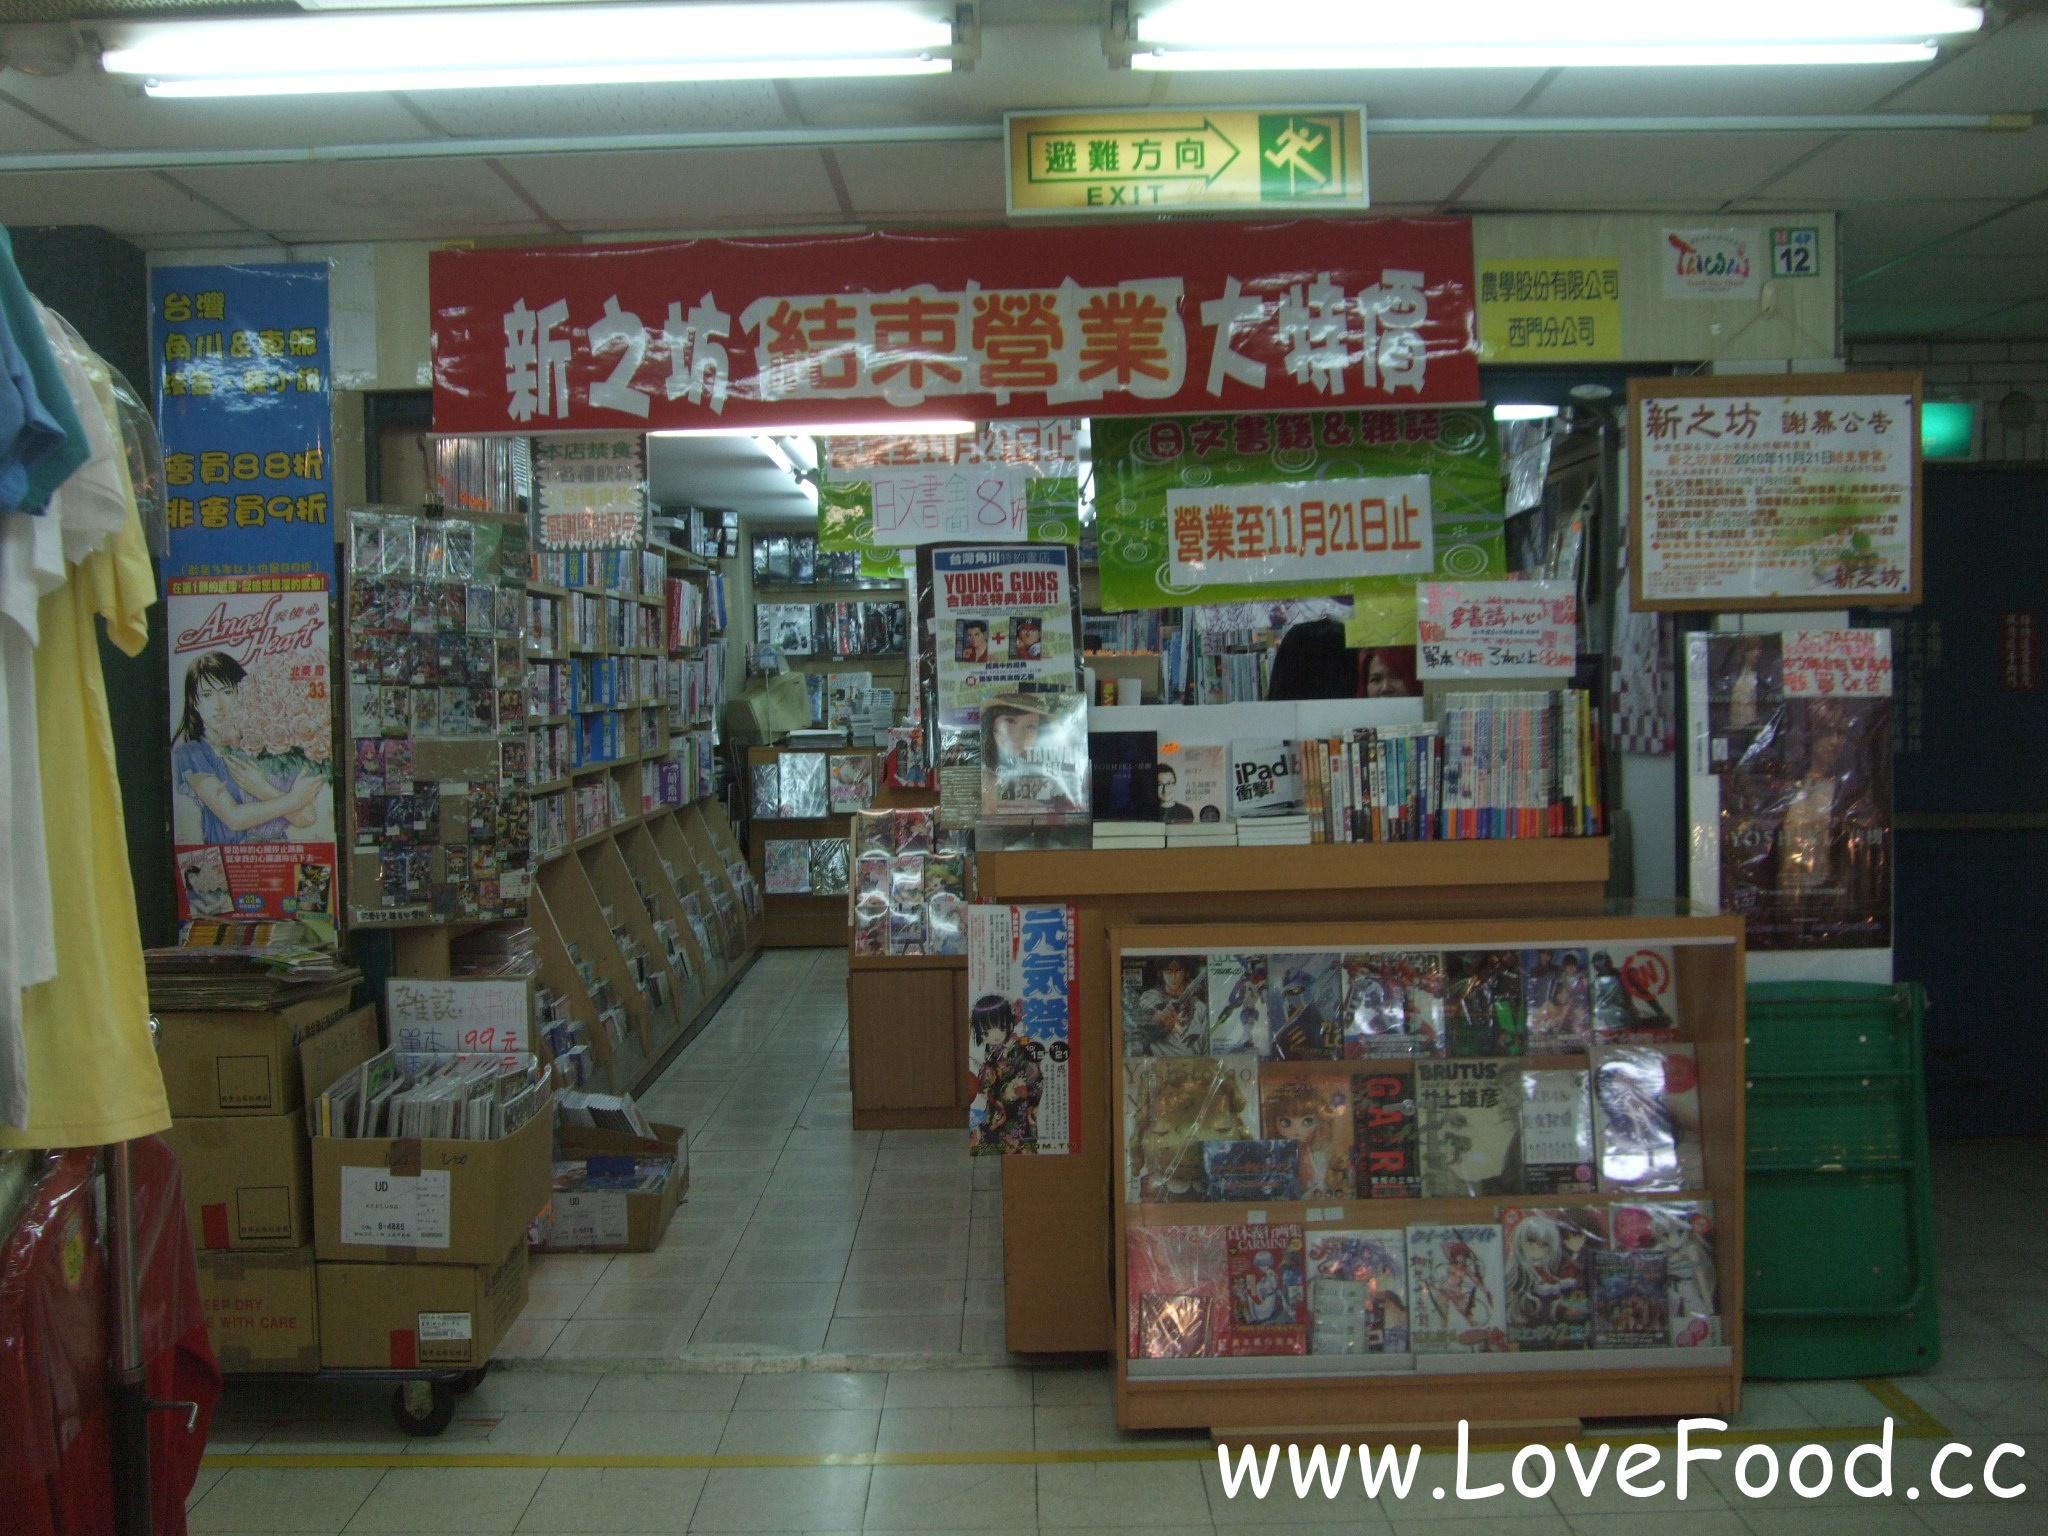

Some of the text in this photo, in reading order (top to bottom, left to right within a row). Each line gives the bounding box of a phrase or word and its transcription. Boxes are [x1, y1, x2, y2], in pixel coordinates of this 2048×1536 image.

[1045, 138, 1206, 173] 避難方向
[1087, 185, 1163, 206] EXIT
[1779, 247, 1810, 272] 12
[1482, 269, 1619, 303] 農學股份有限公司
[163, 291, 225, 322] 台灣
[1508, 316, 1594, 348] 西門分公司
[1647, 403, 1893, 441] 新之坊 謝幕公告
[165, 449, 324, 485] 會員88折
[166, 492, 328, 529] 非會員9折
[1174, 493, 1421, 562] 營業至11月21日止
[944, 571, 1058, 595] YOUNG GUNS
[176, 594, 284, 649] Angel
[239, 617, 325, 664] Heart
[308, 681, 325, 699] 33
[1235, 755, 1289, 784] iPad
[1235, 779, 1275, 802] 衝擊!
[1022, 908, 1070, 1040] 元氣祭
[1419, 1062, 1498, 1080] BRUTUS
[375, 1181, 388, 1192] UD
[203, 1298, 262, 1312] EEP DRY
[220, 1316, 254, 1329] WITH
[260, 1315, 296, 1329] CARE
